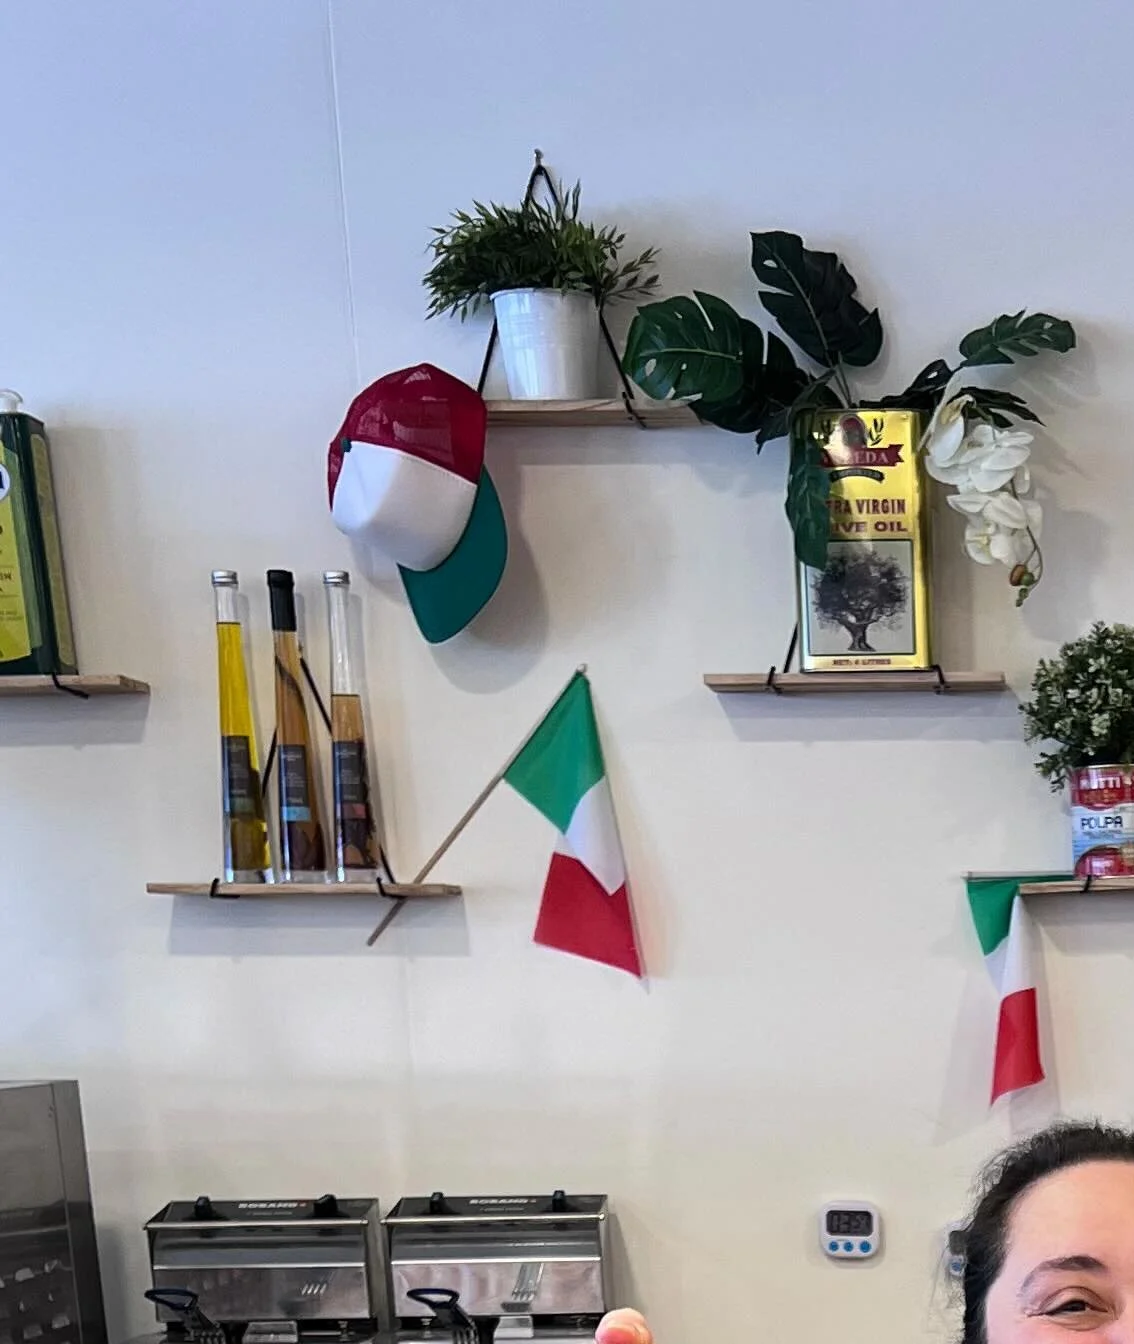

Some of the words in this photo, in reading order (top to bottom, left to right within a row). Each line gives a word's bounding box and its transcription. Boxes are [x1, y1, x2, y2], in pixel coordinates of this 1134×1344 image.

[855, 498, 905, 514] VIRGIN
[874, 521, 908, 532] OIL
[1081, 815, 1123, 830] POLPA
